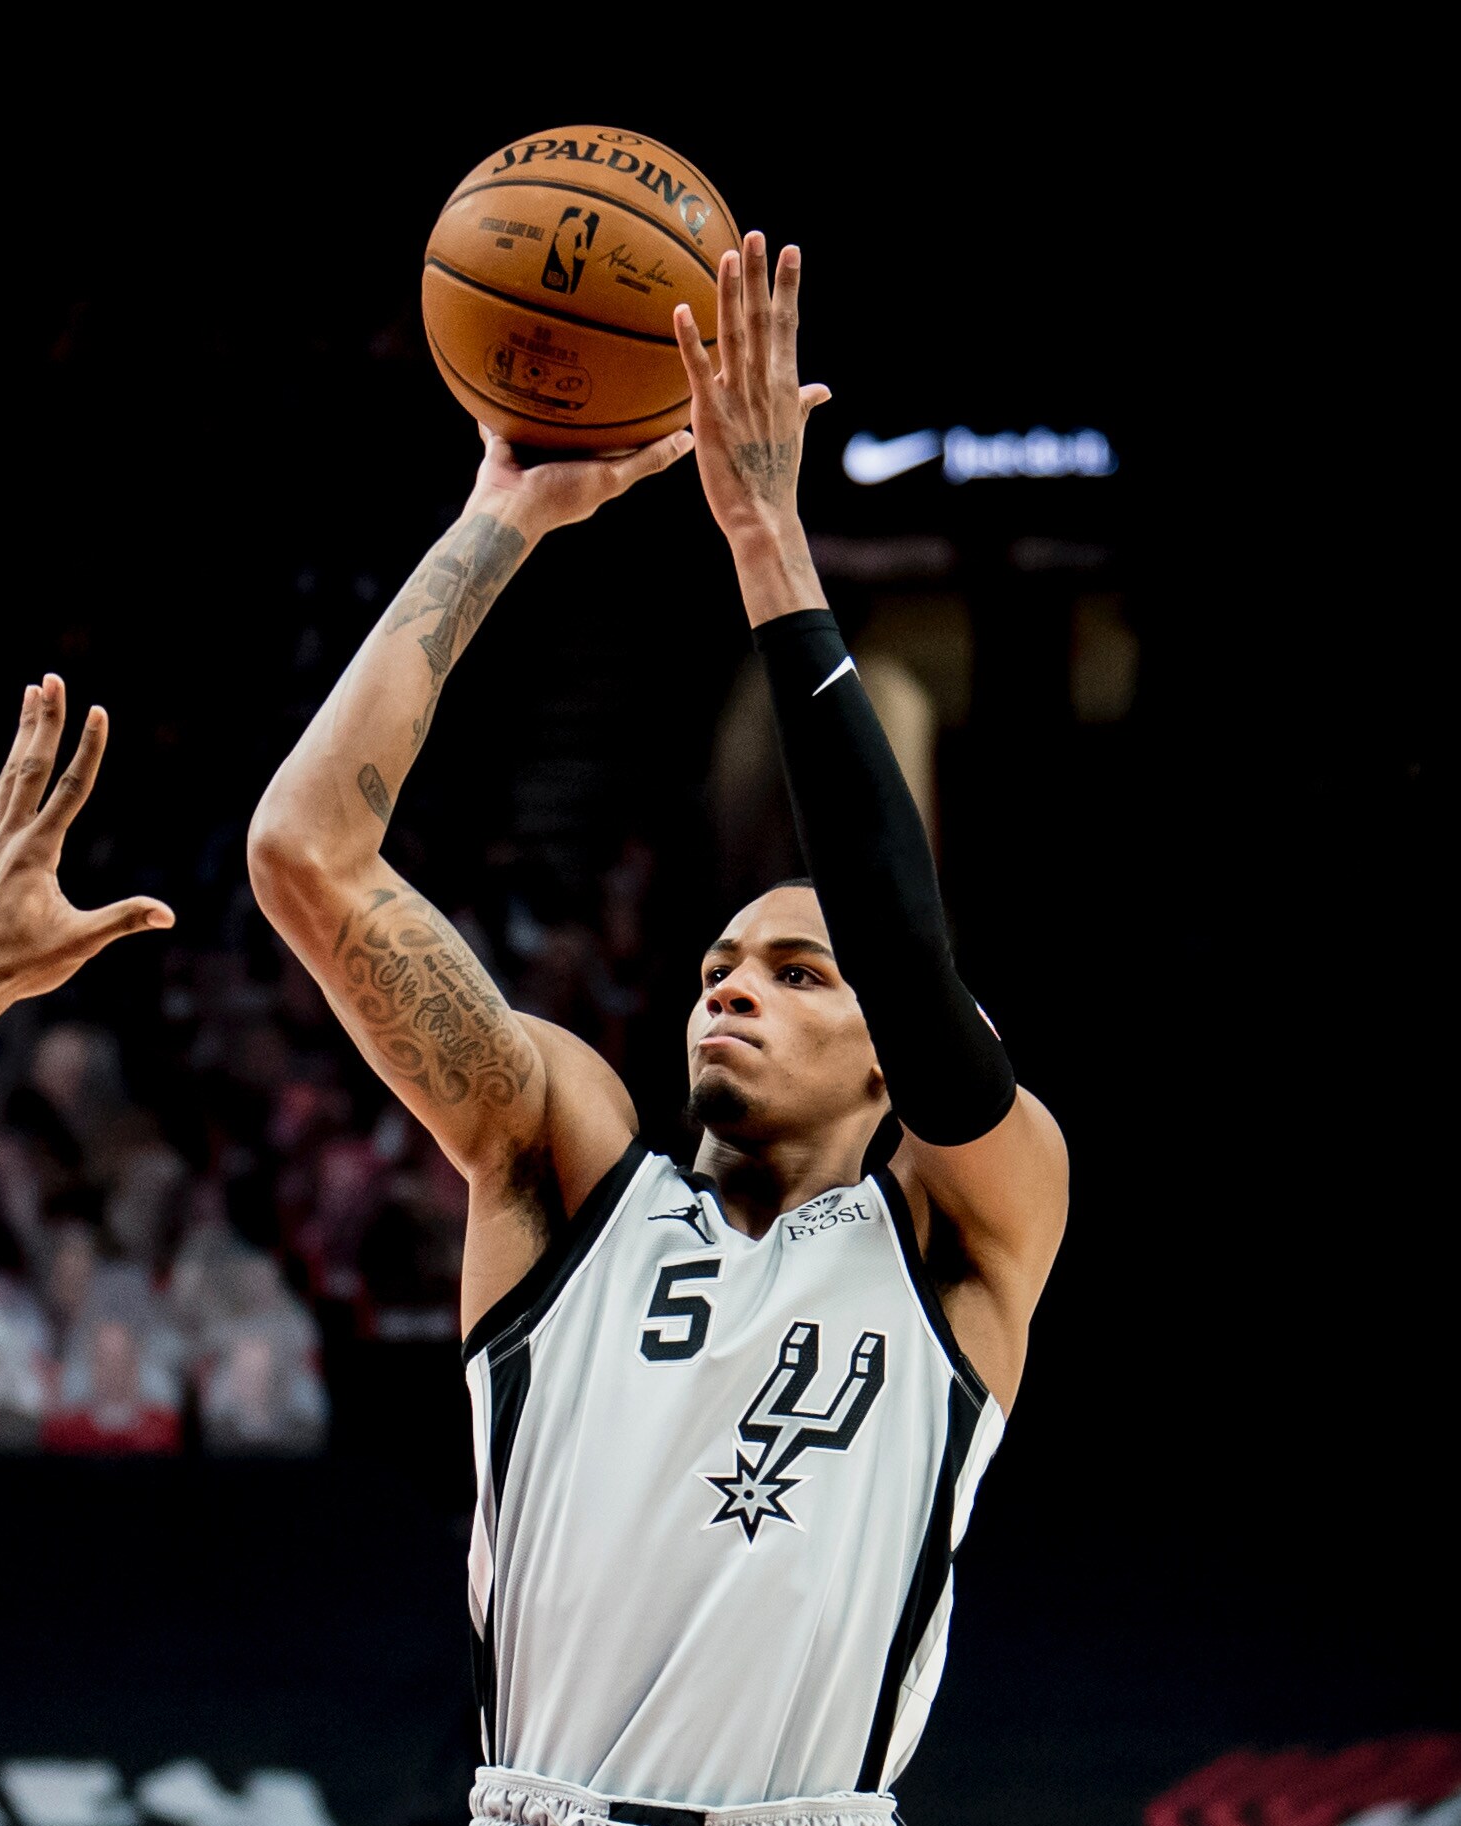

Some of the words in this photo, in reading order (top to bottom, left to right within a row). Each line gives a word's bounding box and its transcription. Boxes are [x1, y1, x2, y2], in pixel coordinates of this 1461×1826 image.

[492, 138, 713, 237] SPALDING
[785, 1202, 871, 1241] Frost
[640, 1258, 722, 1362] 5
